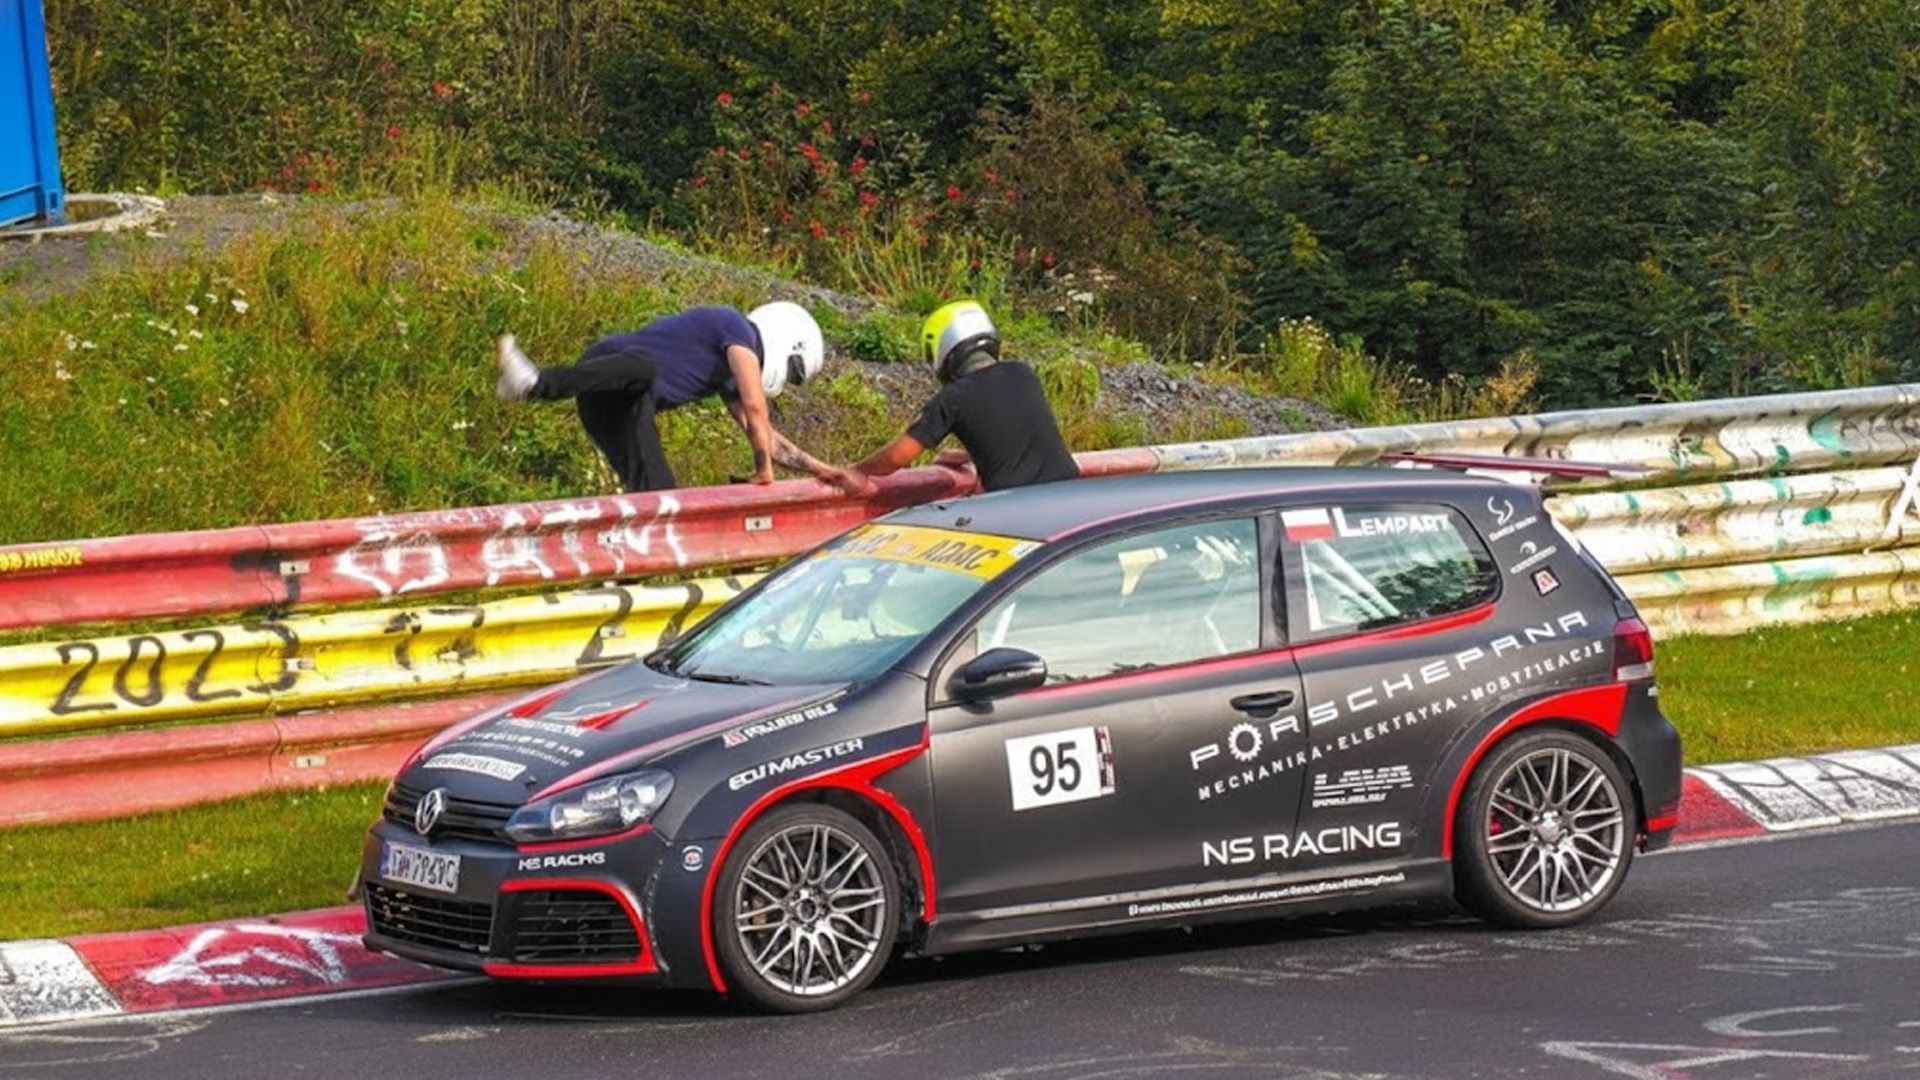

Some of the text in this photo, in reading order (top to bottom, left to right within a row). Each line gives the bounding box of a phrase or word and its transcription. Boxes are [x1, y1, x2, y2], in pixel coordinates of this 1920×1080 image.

[1029, 740, 1082, 797] 95
[1202, 822, 1401, 867] NS RACING
